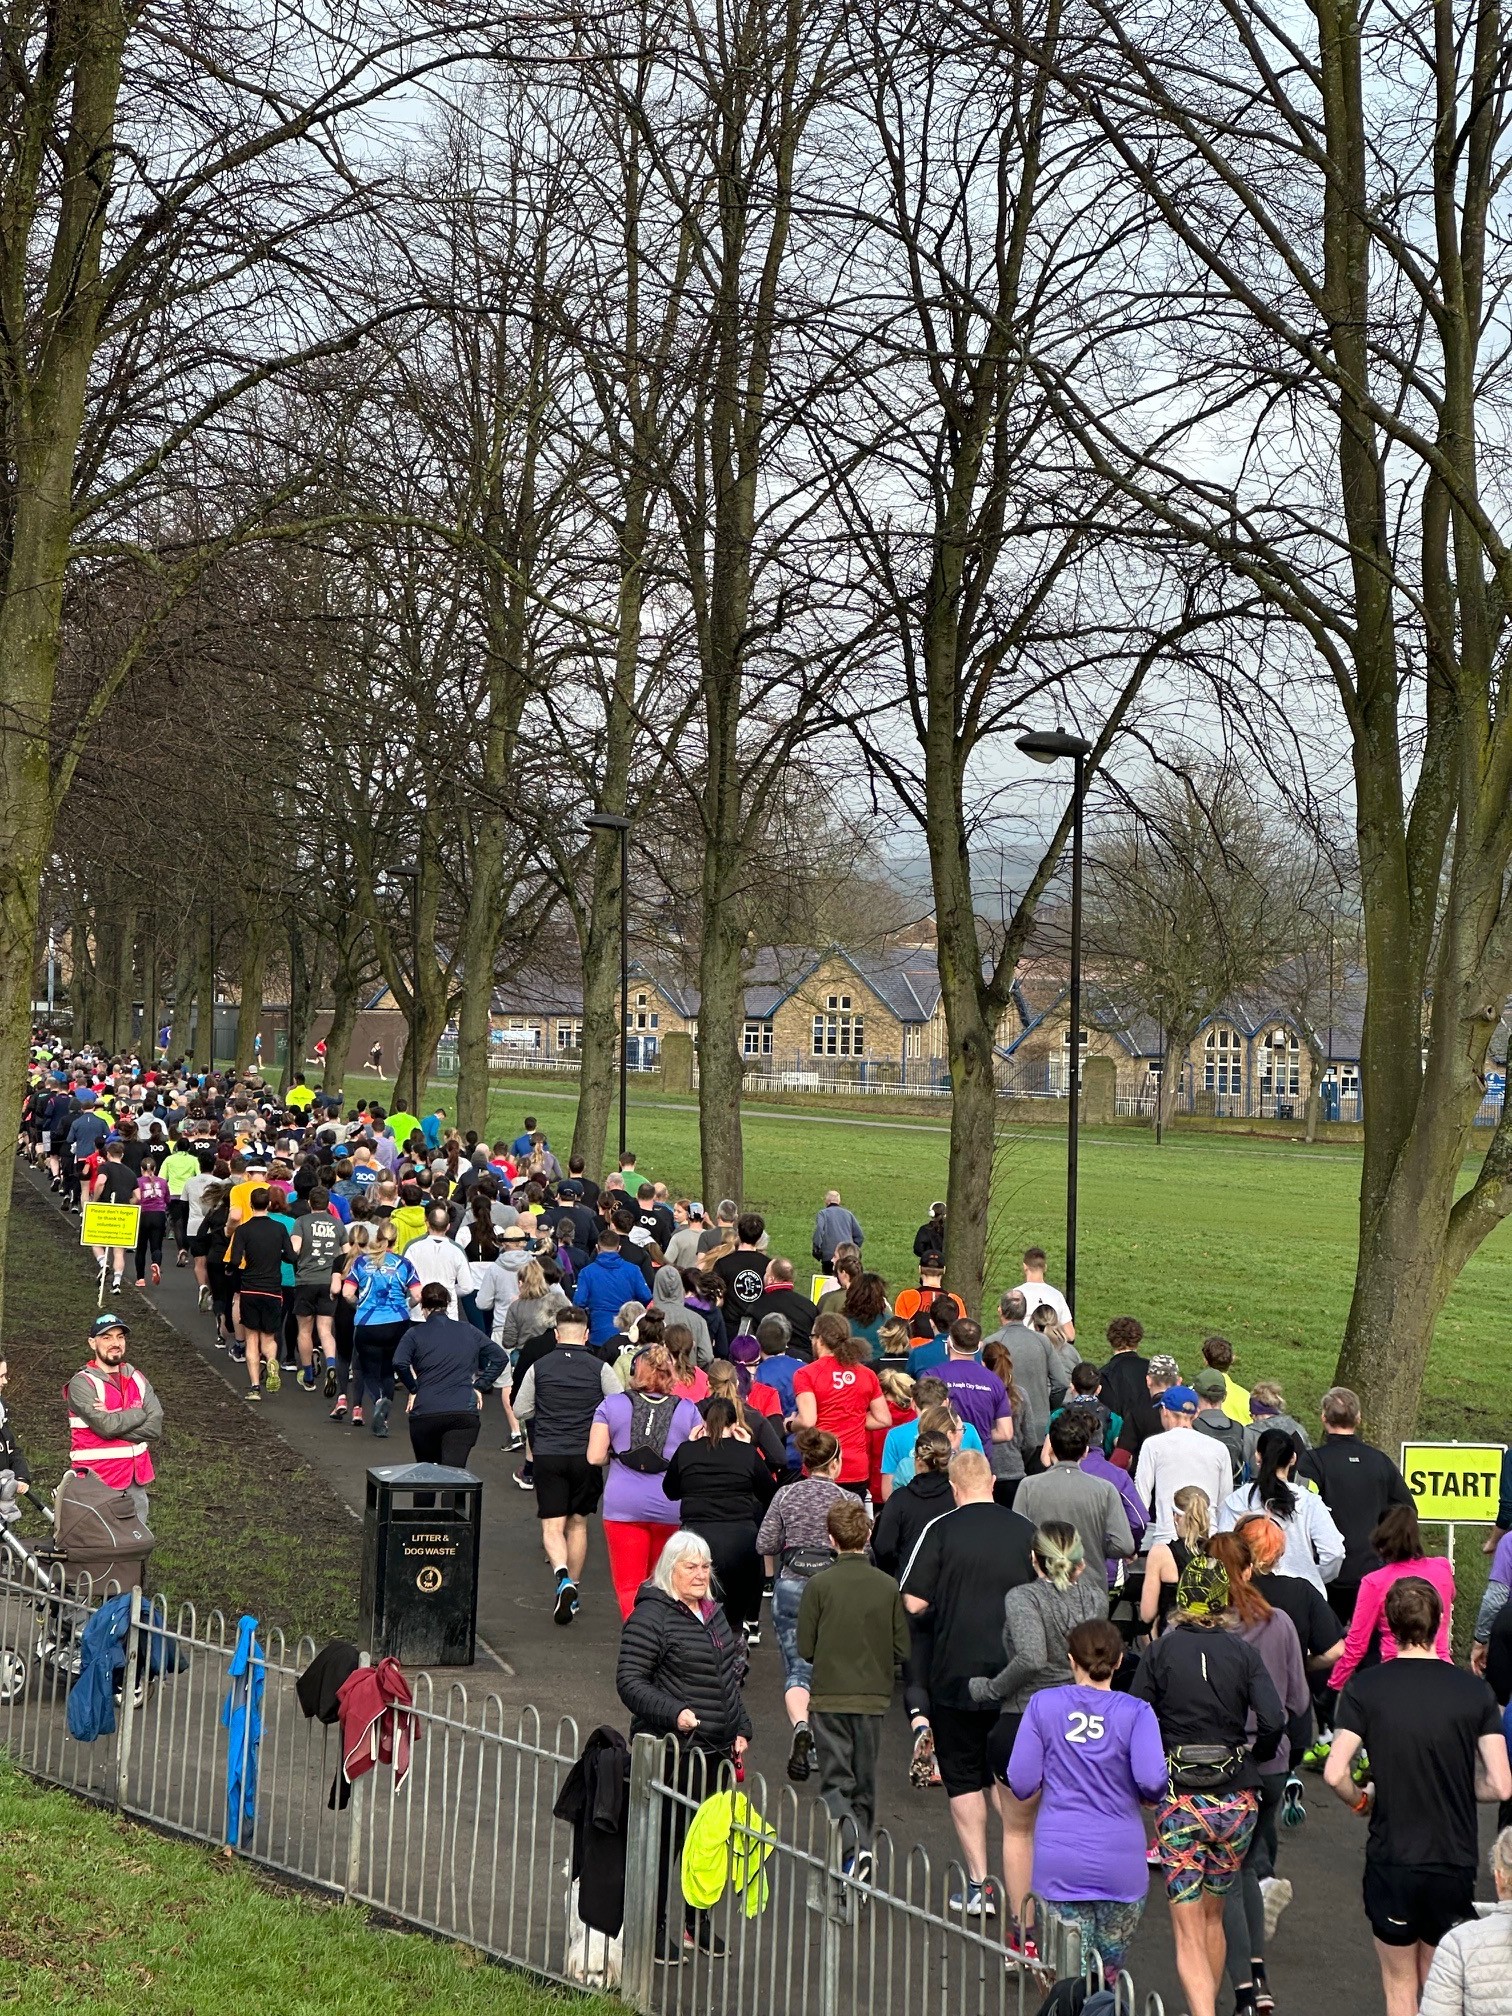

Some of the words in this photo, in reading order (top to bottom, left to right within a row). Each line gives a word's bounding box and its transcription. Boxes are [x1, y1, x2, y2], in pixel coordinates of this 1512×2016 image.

[150, 1144, 164, 1153] 100
[194, 1142, 210, 1150] 100
[355, 1172, 376, 1181] 200
[832, 1370, 856, 1390] 50
[1410, 1471, 1497, 1497] START
[411, 1534, 442, 1542] LITTER
[442, 1534, 449, 1542] &
[404, 1547, 424, 1556] DOG
[425, 1547, 456, 1556] WASTE
[1065, 1712, 1105, 1743] 25
